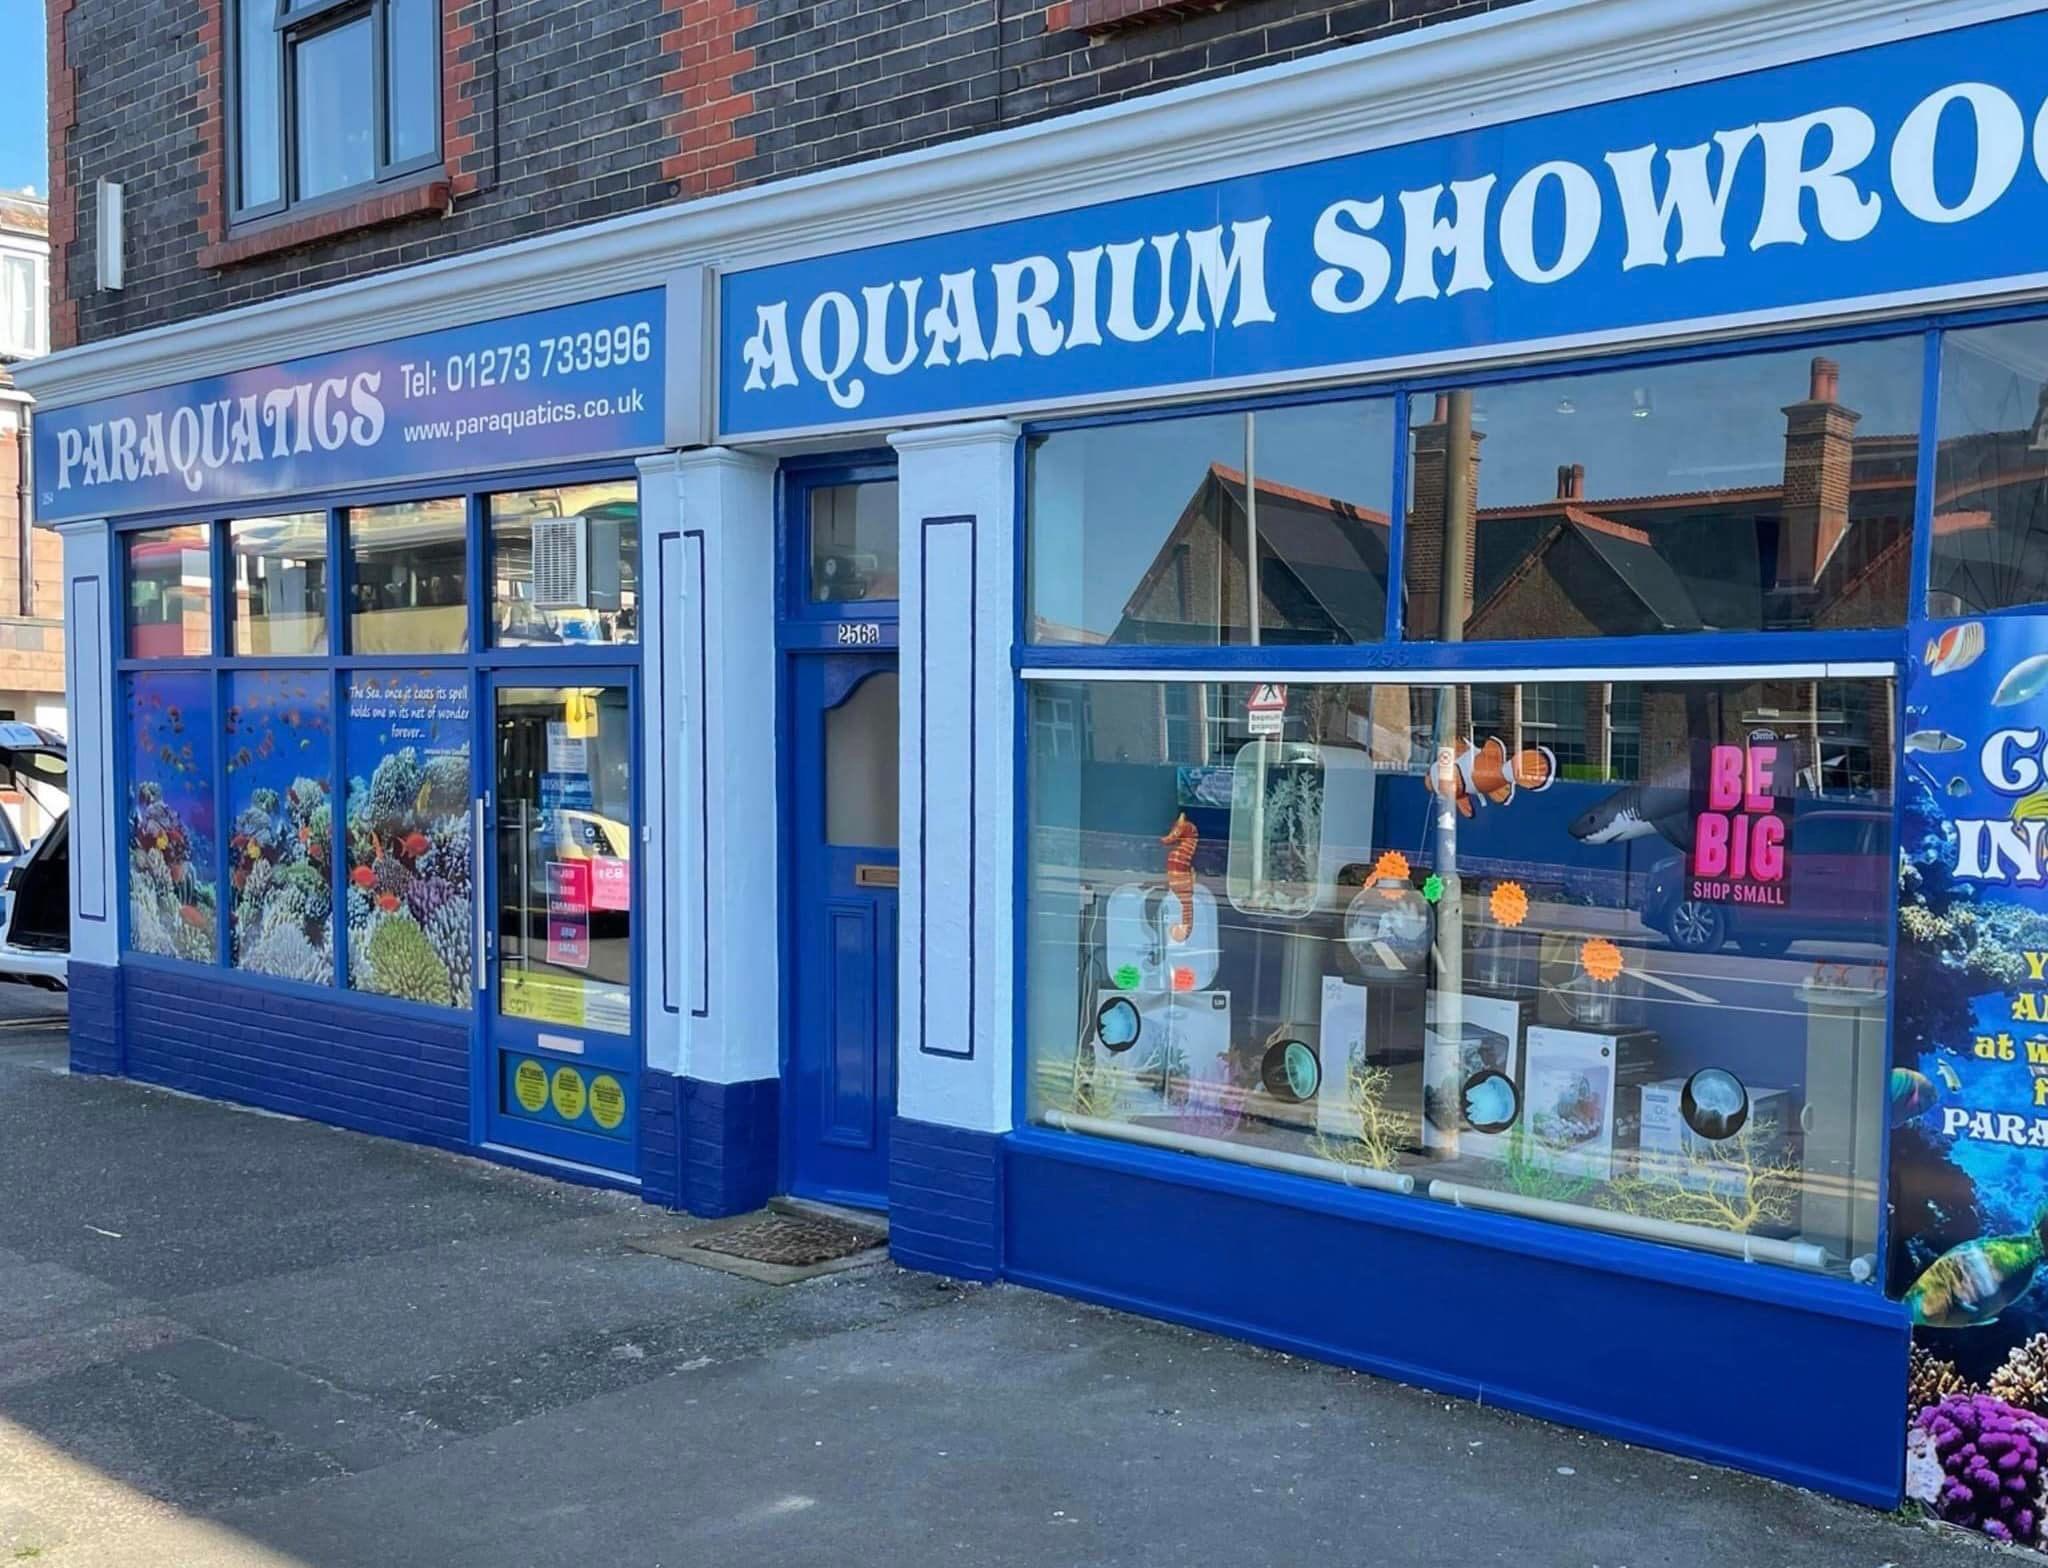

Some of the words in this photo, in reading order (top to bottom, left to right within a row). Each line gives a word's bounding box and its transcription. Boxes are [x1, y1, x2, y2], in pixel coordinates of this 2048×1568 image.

[744, 216, 1276, 409] AQUARIUM
[1310, 82, 2048, 314] SHOWRO
[401, 363, 437, 398] Tel:
[447, 343, 531, 393] 01273
[539, 321, 651, 378] 733996
[57, 371, 385, 492] PARAQUATICS
[403, 388, 644, 443] www.paraquatics.co.uk
[839, 623, 878, 645] 256a
[349, 686, 364, 699] The
[384, 688, 402, 700] once
[403, 686, 412, 700] it
[413, 688, 435, 700] casts
[436, 686, 447, 700] its
[351, 704, 371, 718] holds
[372, 708, 387, 718] one
[388, 704, 398, 718] in
[399, 704, 410, 718] its
[410, 707, 426, 718] net
[427, 704, 437, 719] of
[438, 705, 469, 719] wonder
[1710, 745, 1778, 813] BE
[1981, 727, 2048, 793] C
[1695, 812, 1785, 881] BIG
[1952, 818, 2048, 882] IN
[1693, 881, 1730, 899] SHOP
[1733, 885, 1784, 904] SMALL
[2012, 992, 2048, 1022] A
[1974, 1033, 2015, 1061] at
